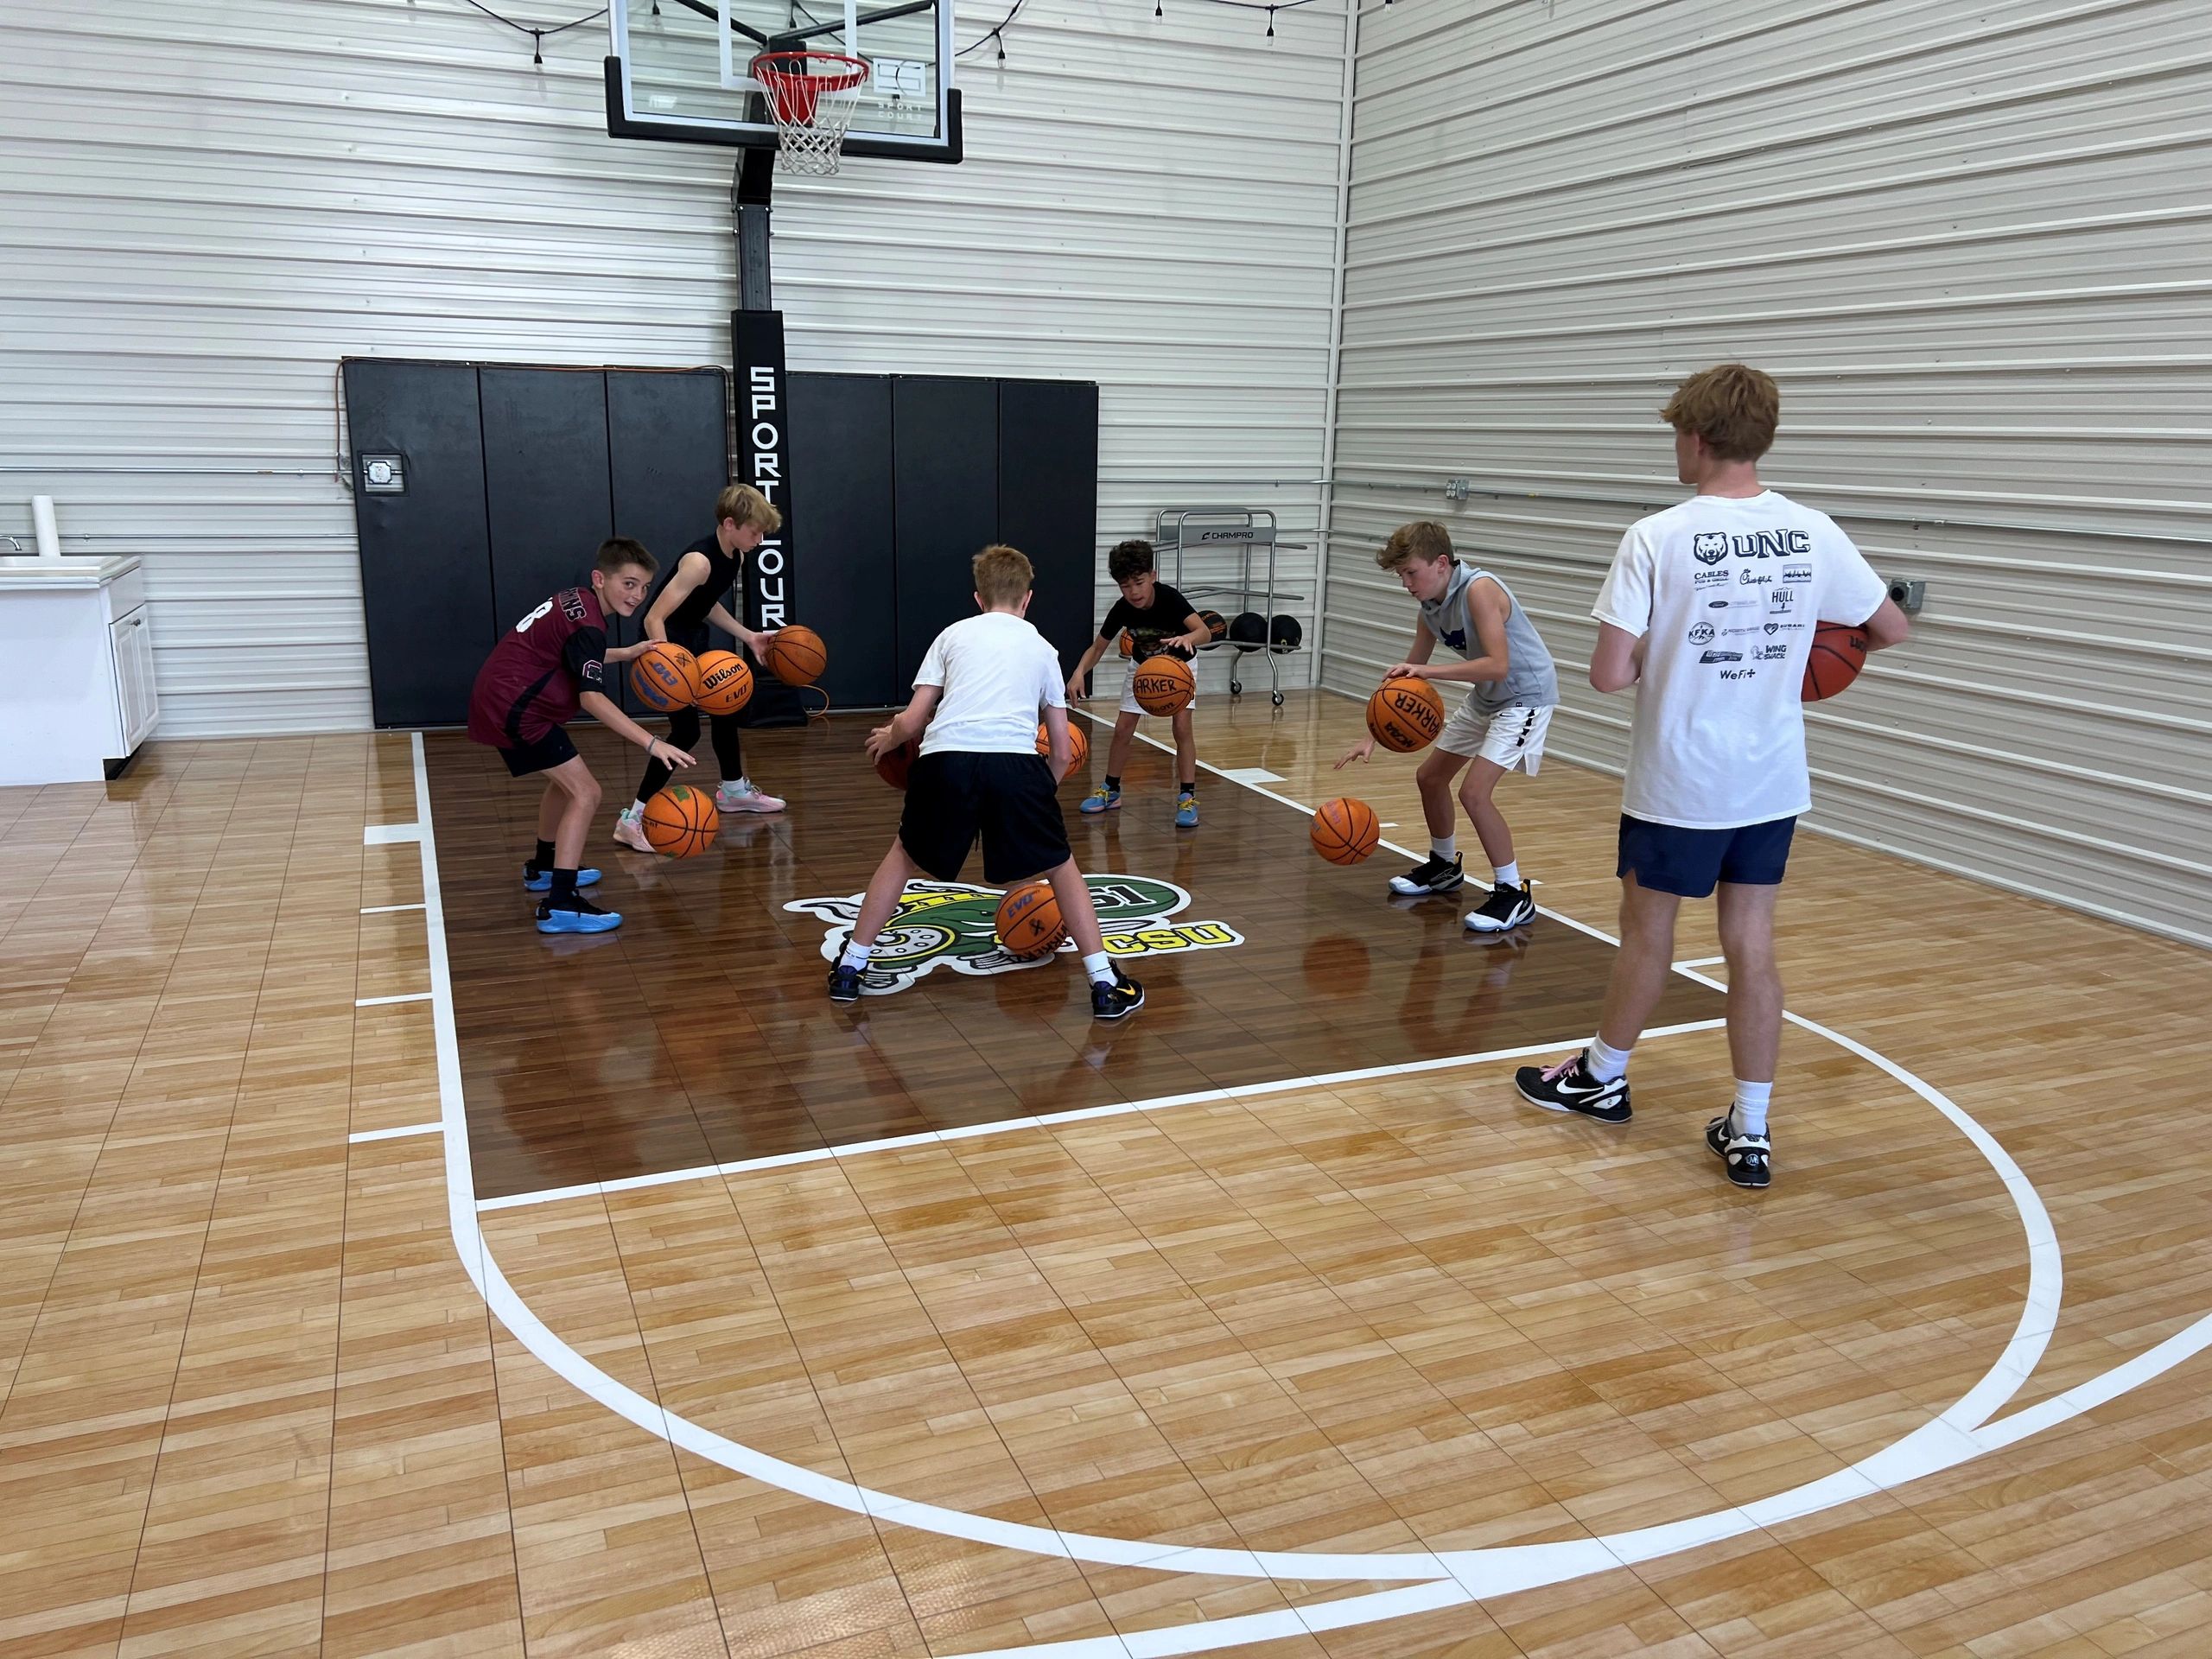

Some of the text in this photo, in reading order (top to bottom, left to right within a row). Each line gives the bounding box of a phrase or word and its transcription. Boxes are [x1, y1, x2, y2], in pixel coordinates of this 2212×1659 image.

[878, 102, 923, 111] SPORT
[878, 111, 923, 120] COURT
[750, 366, 782, 505] SPORT
[1732, 529, 1811, 558] UNC
[758, 531, 788, 634] OUR
[1771, 590, 1794, 603] HULL
[1765, 645, 1787, 653] WING
[702, 664, 743, 690] Wilson
[1102, 924, 1236, 955] CSU
